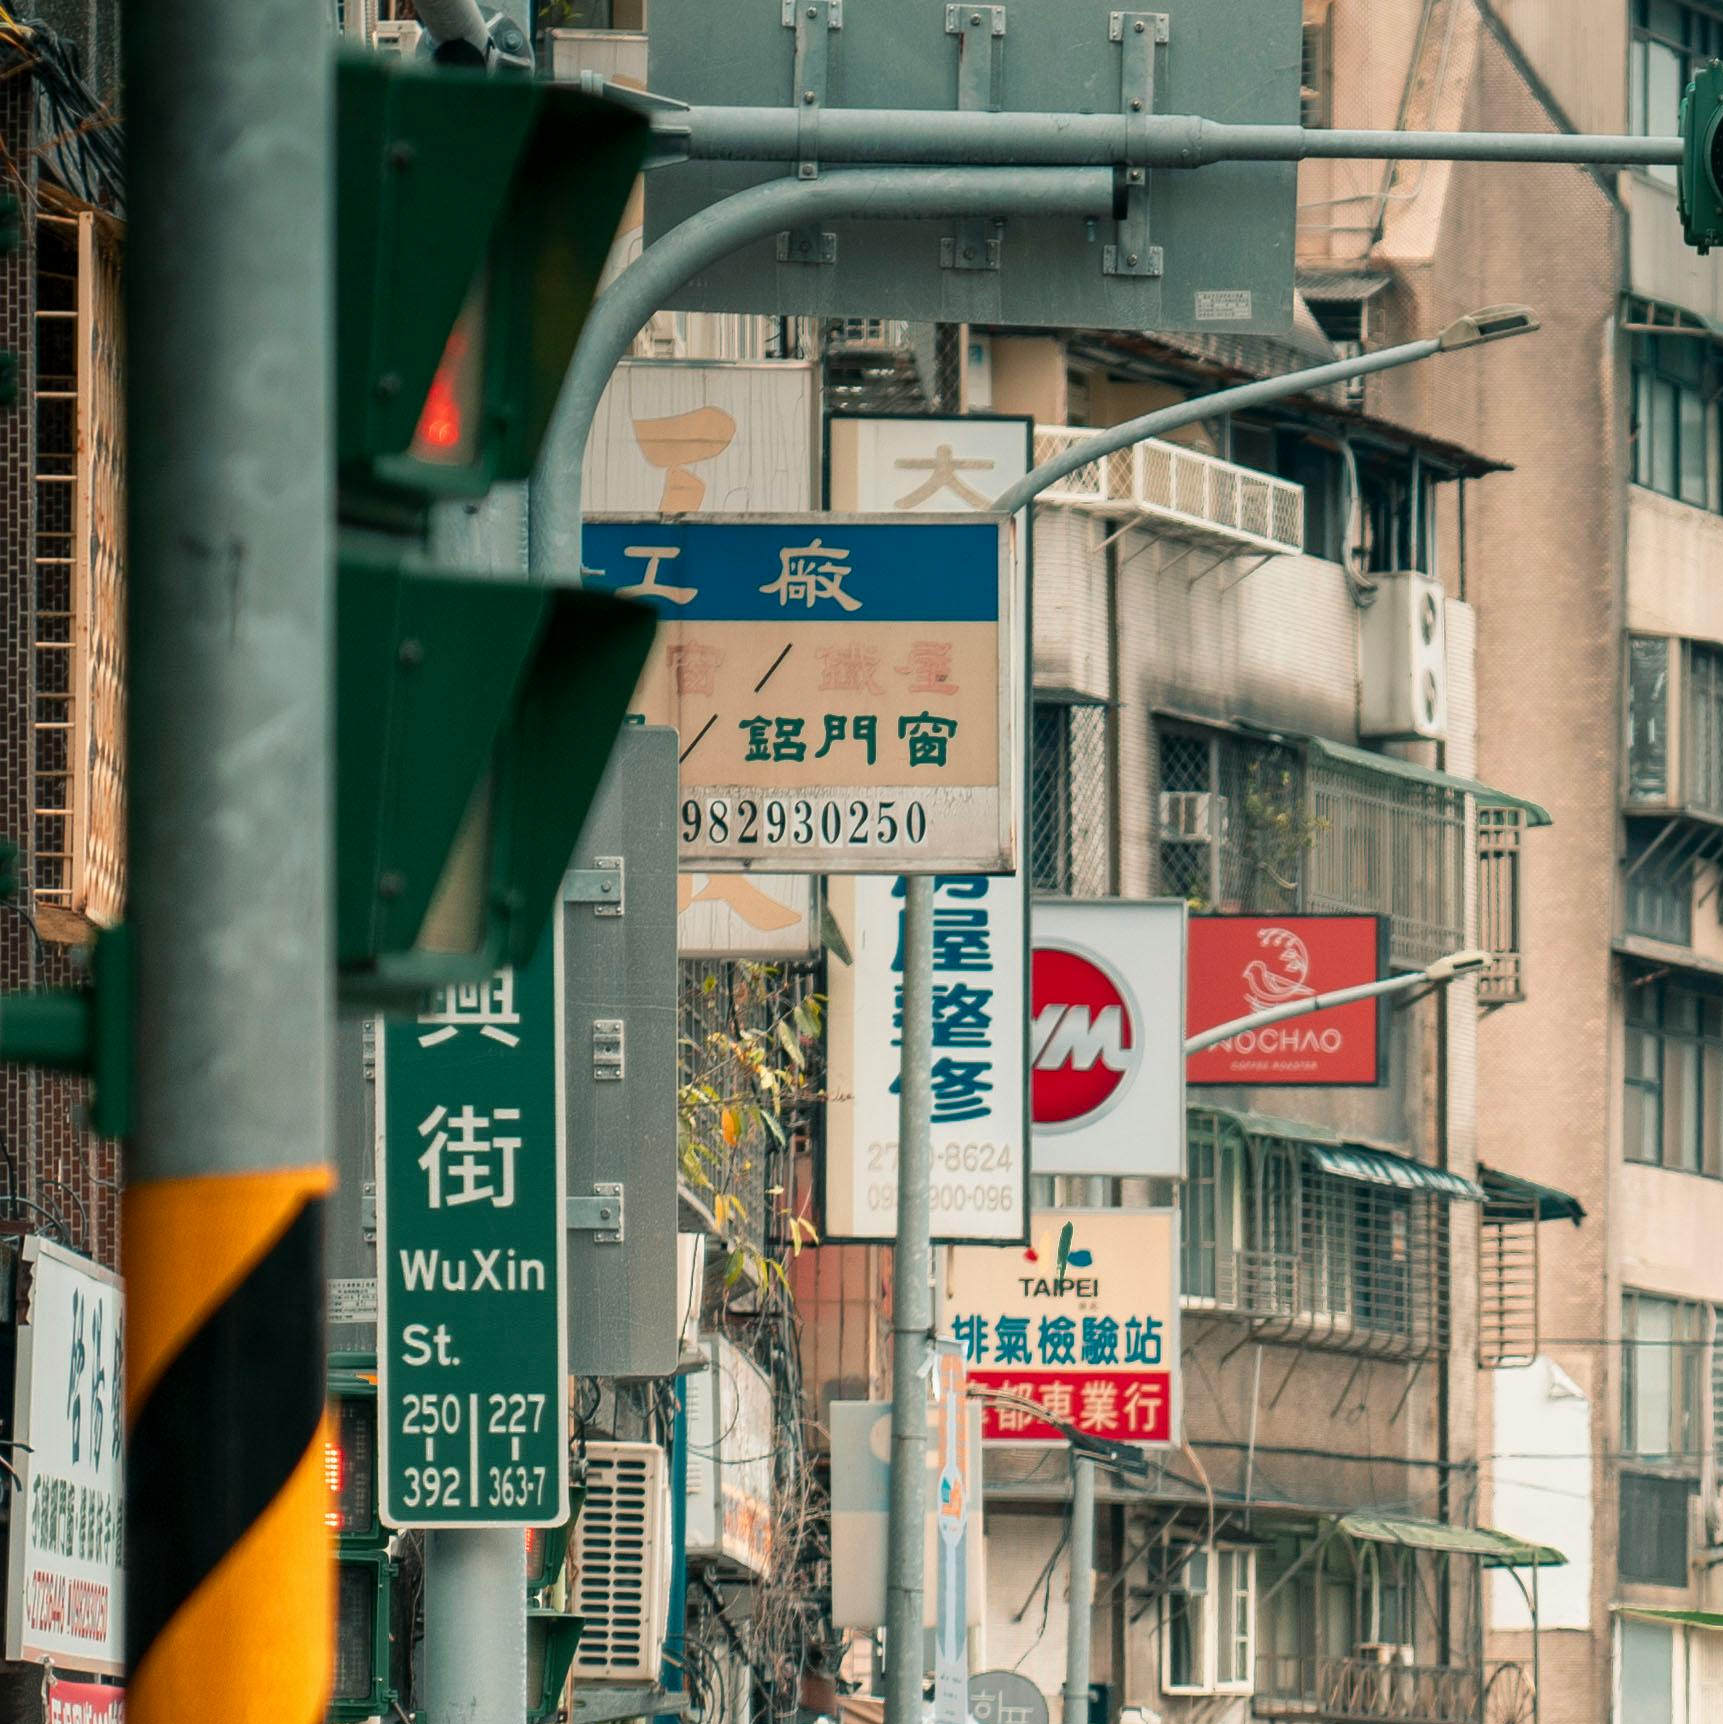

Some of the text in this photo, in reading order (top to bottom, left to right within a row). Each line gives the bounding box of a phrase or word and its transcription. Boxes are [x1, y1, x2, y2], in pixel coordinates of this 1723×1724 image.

[615, 538, 863, 612] 工廠
[682, 800, 927, 844] 982930250
[400, 1249, 545, 1291] WuXin
[1019, 1278, 1099, 1297] TAIPEI
[402, 1324, 460, 1366] St.
[951, 1314, 1163, 1366] 排氣檢驗站
[403, 1395, 545, 1435] 250 227
[967, 1380, 1163, 1433] 都車業行
[403, 1467, 545, 1508] 392 363-7
